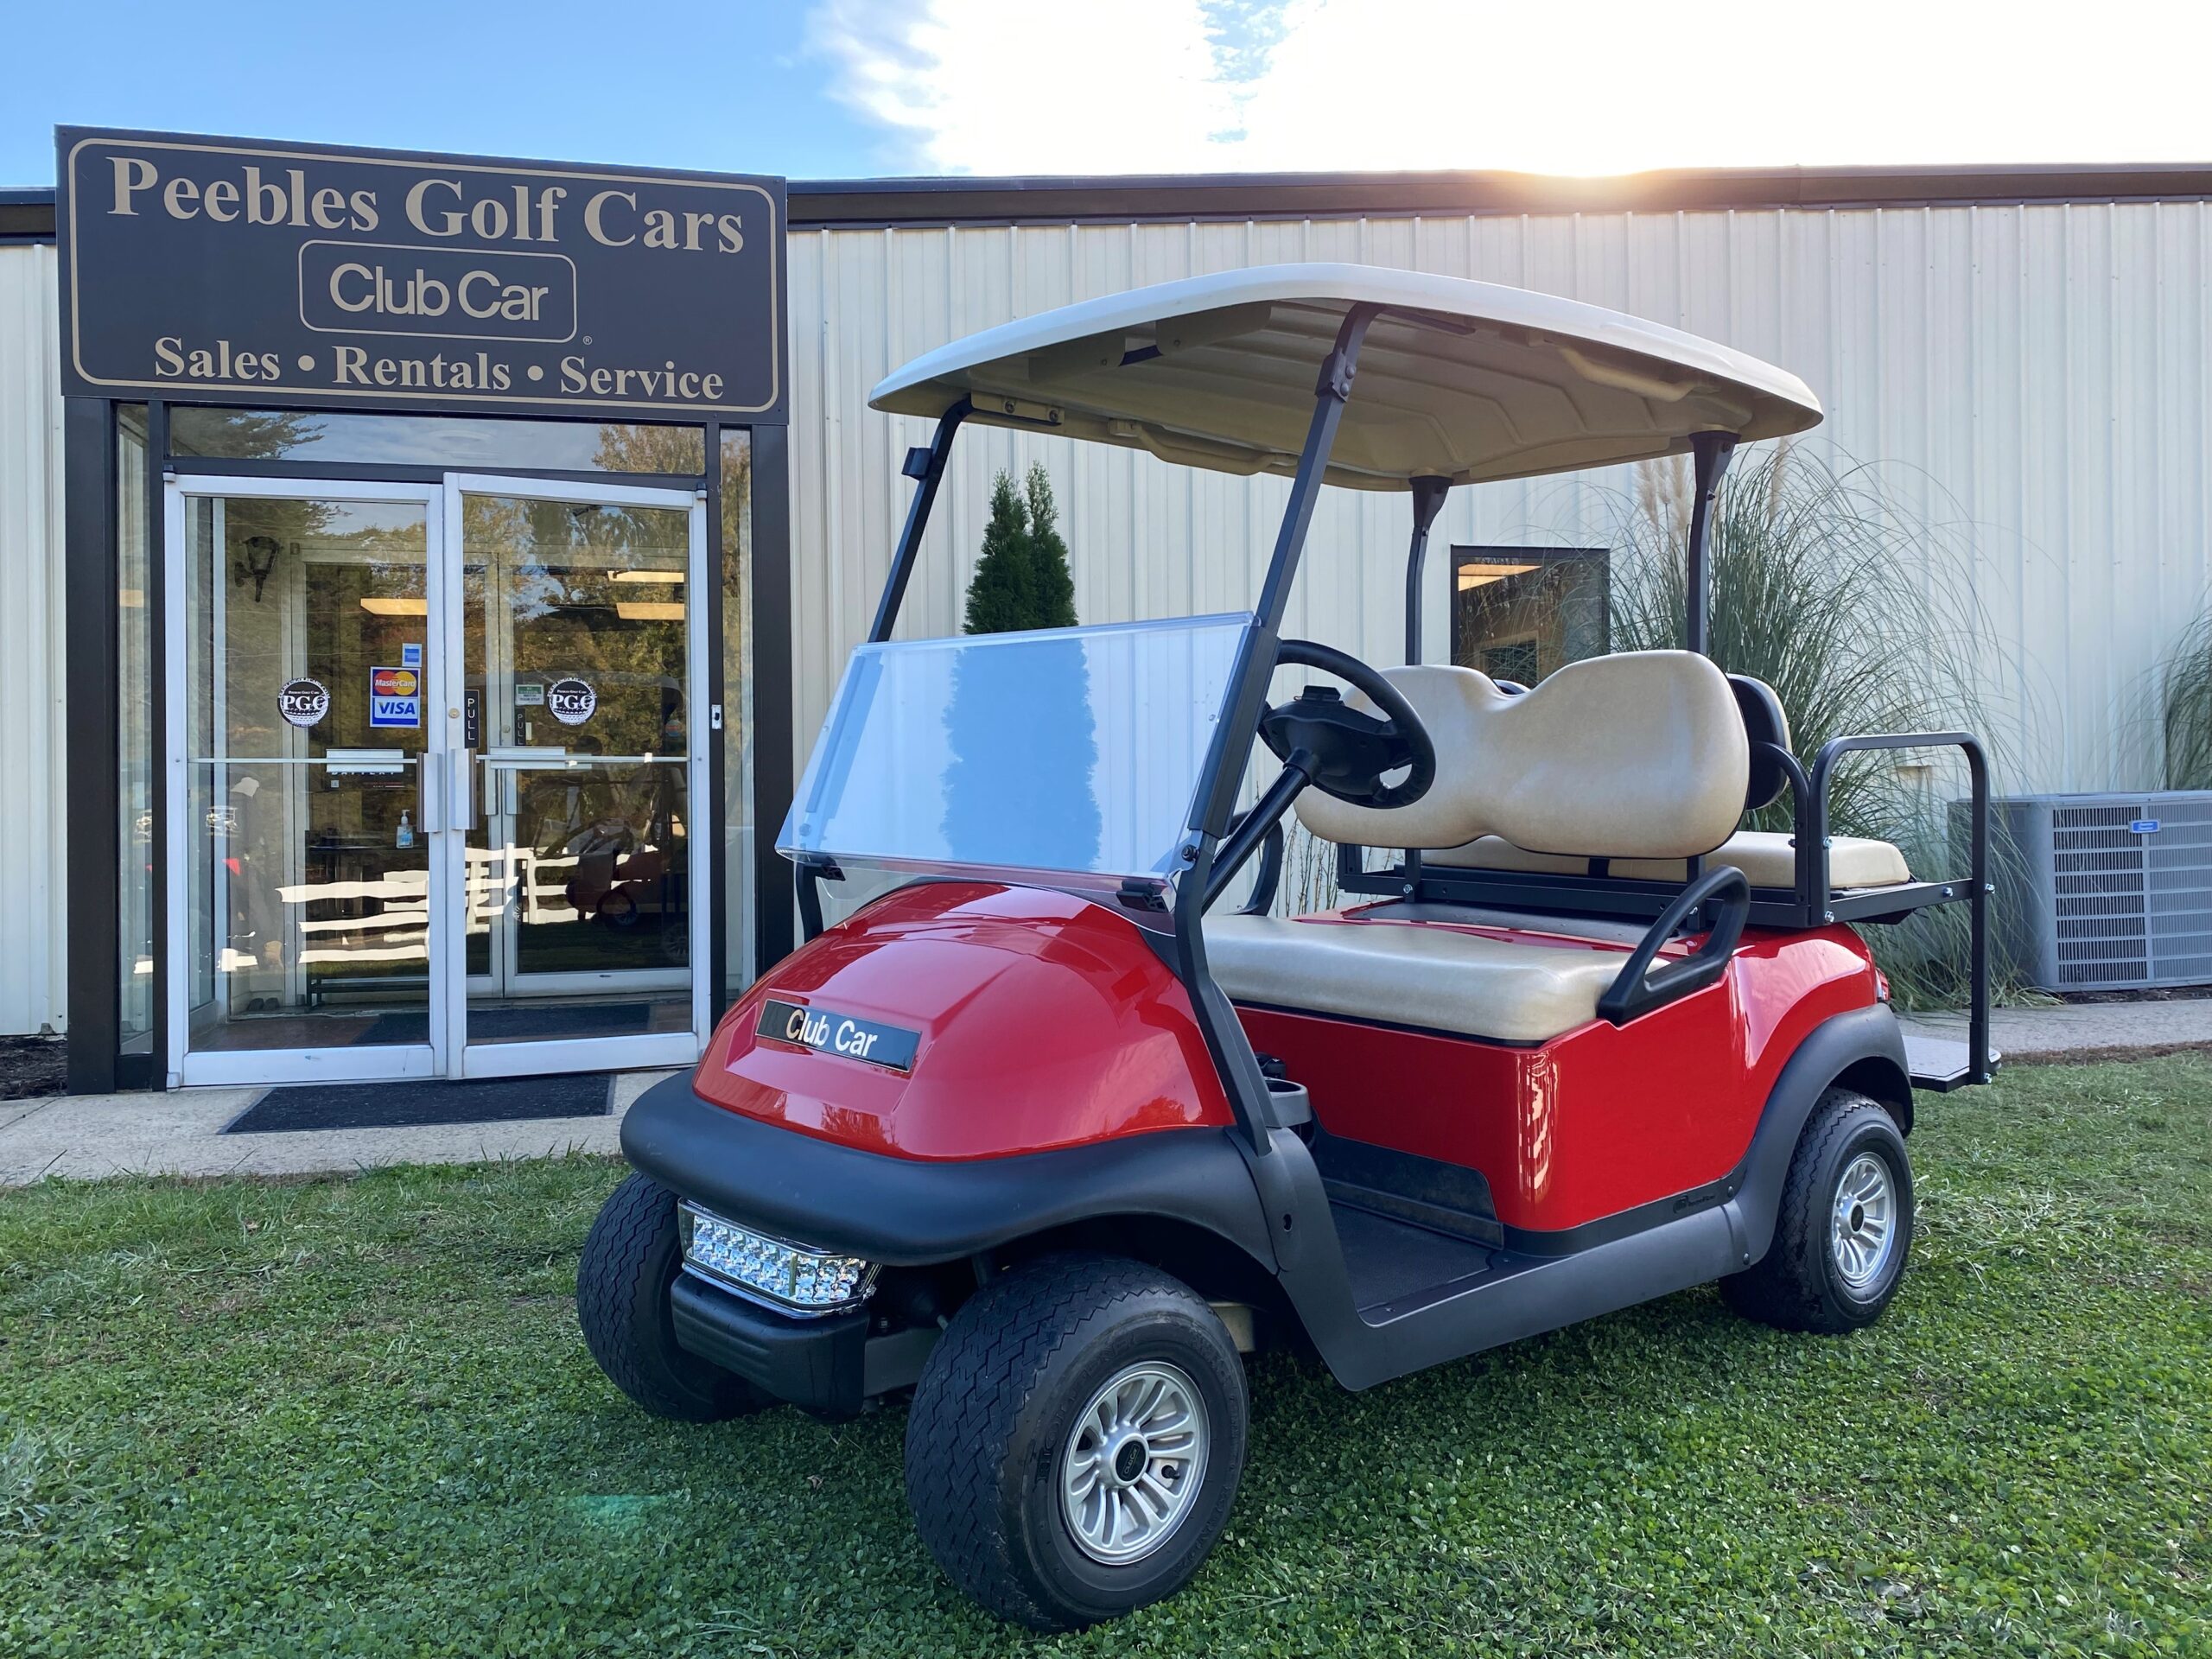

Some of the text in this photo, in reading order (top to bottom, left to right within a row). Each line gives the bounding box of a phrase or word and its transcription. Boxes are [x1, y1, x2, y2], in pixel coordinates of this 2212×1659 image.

[105, 156, 745, 254] Peebles Golf Cars
[329, 263, 549, 321] Club Car
[155, 336, 724, 400] Sales Rentals Service
[283, 695, 326, 710] PGC
[378, 702, 416, 715] VISA
[552, 694, 593, 709] PGC
[785, 1008, 879, 1057] Club Car
